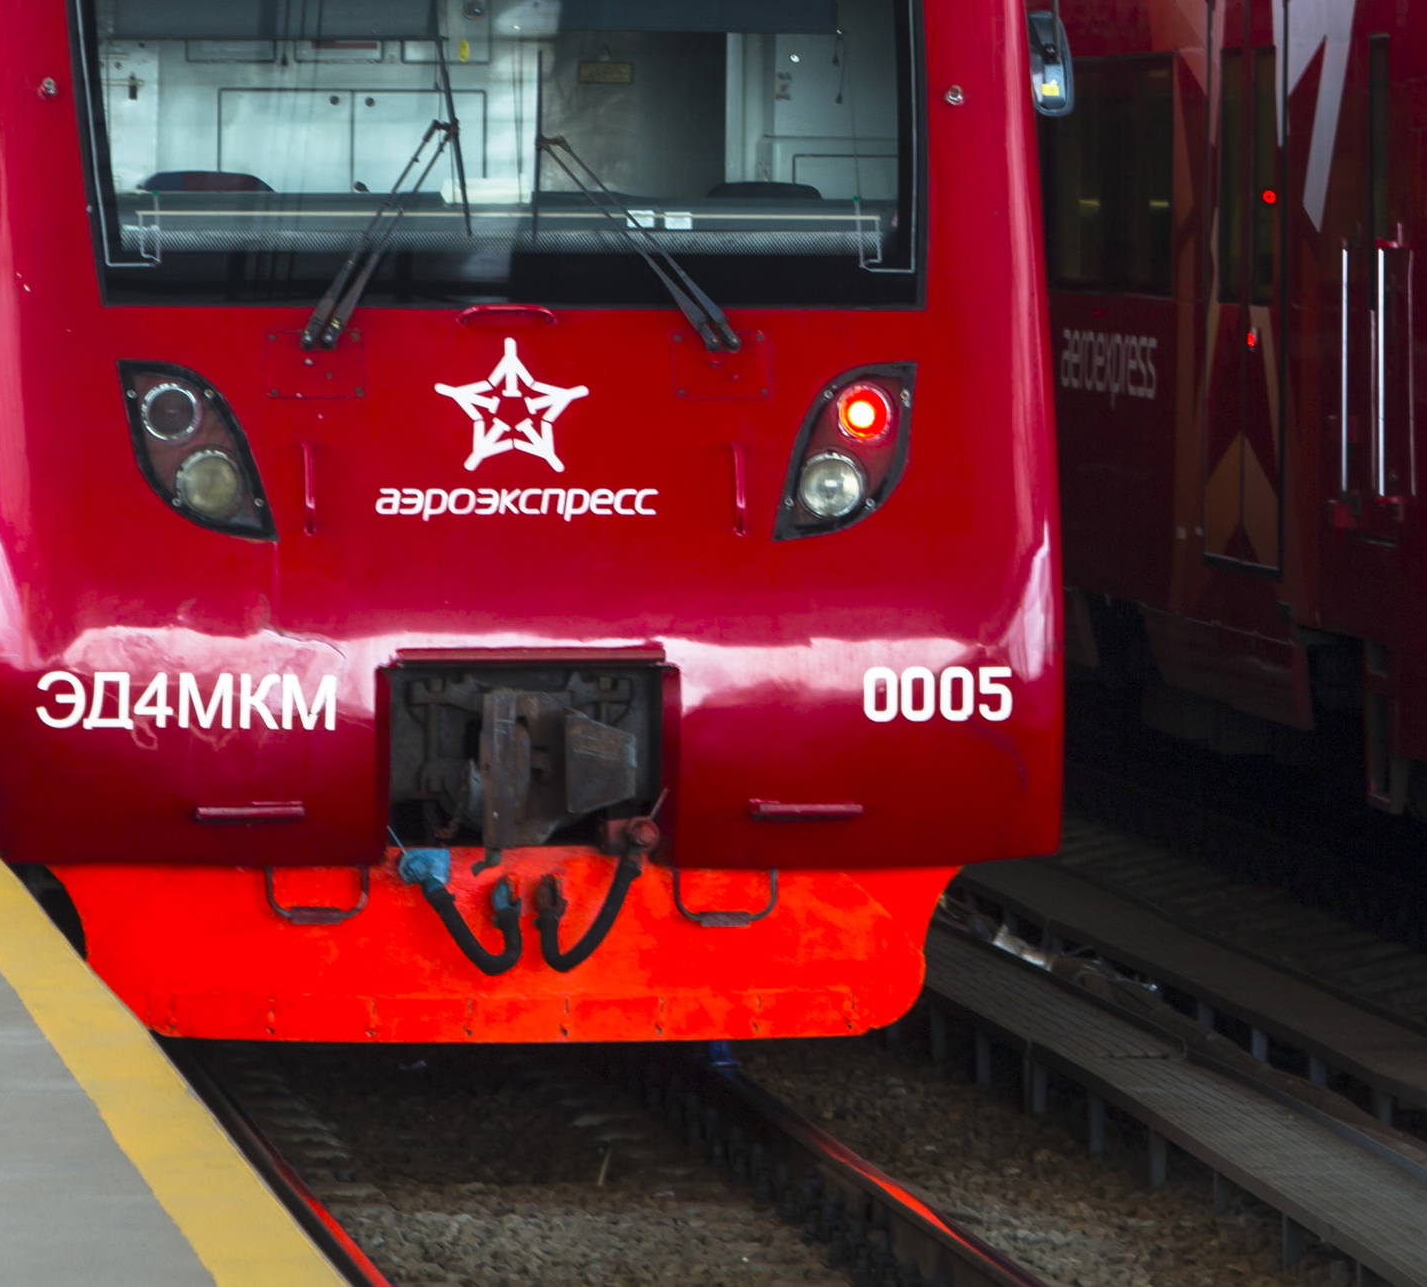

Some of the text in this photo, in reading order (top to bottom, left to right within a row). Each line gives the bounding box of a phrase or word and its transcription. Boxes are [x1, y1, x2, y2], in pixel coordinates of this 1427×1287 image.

[375, 487, 658, 522] аэроэкспресс
[35, 670, 338, 731] ЭД4МКМ
[862, 665, 1013, 723] 0005
